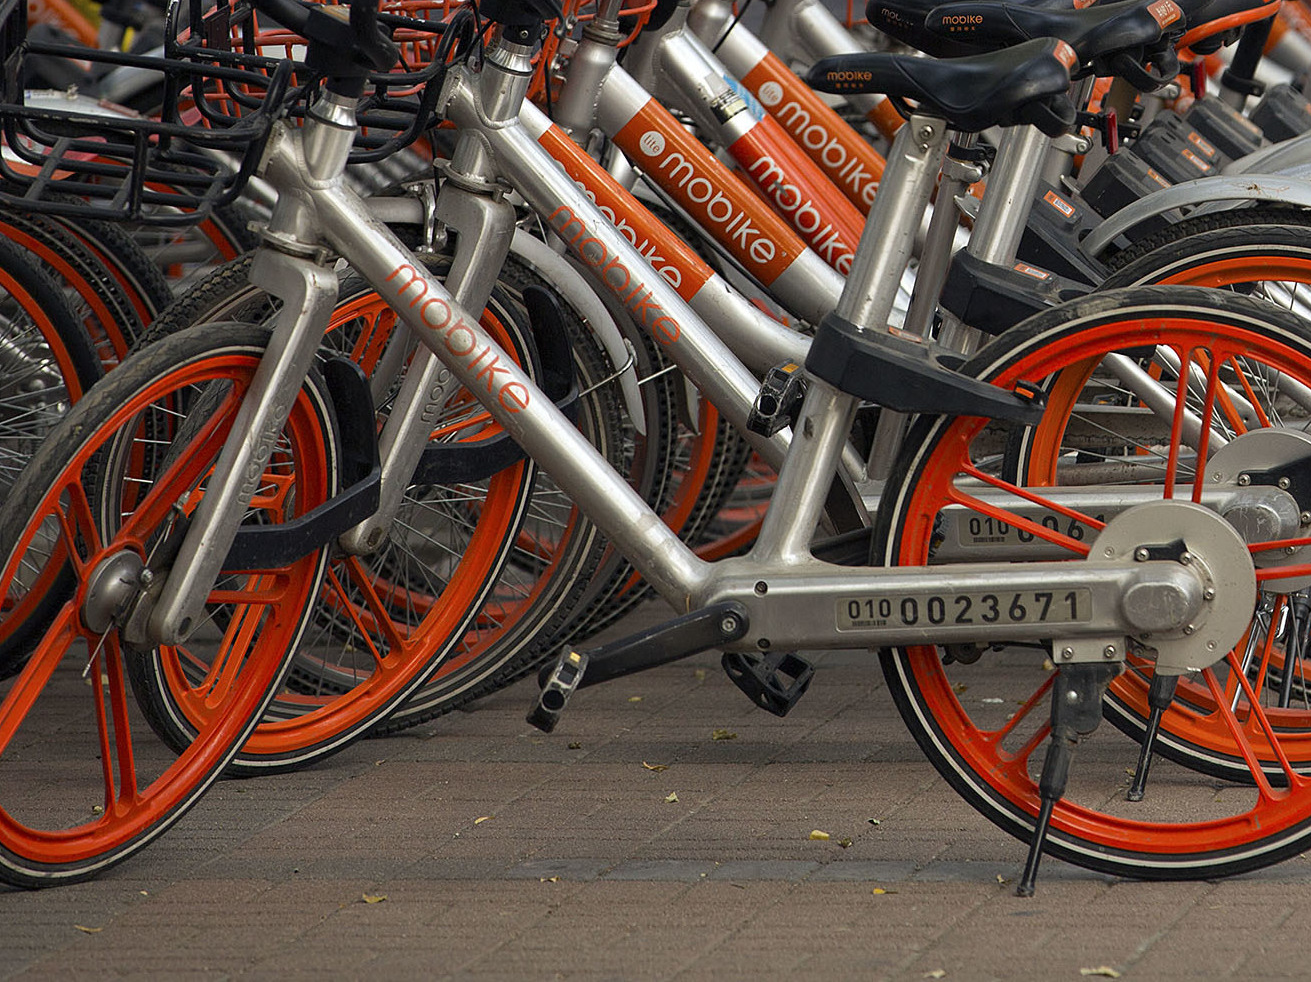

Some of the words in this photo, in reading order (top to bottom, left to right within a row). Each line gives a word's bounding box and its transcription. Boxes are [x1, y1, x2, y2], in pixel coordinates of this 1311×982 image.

[941, 14, 984, 26] mobike
[826, 70, 873, 82] mobike
[642, 134, 660, 154] lite
[777, 102, 880, 206] mobike
[658, 152, 776, 264] mobike
[750, 156, 855, 276] mobike
[547, 205, 681, 345] mobike
[384, 263, 530, 414] mobike
[847, 598, 891, 619] 010
[900, 591, 1080, 626] 0023671
